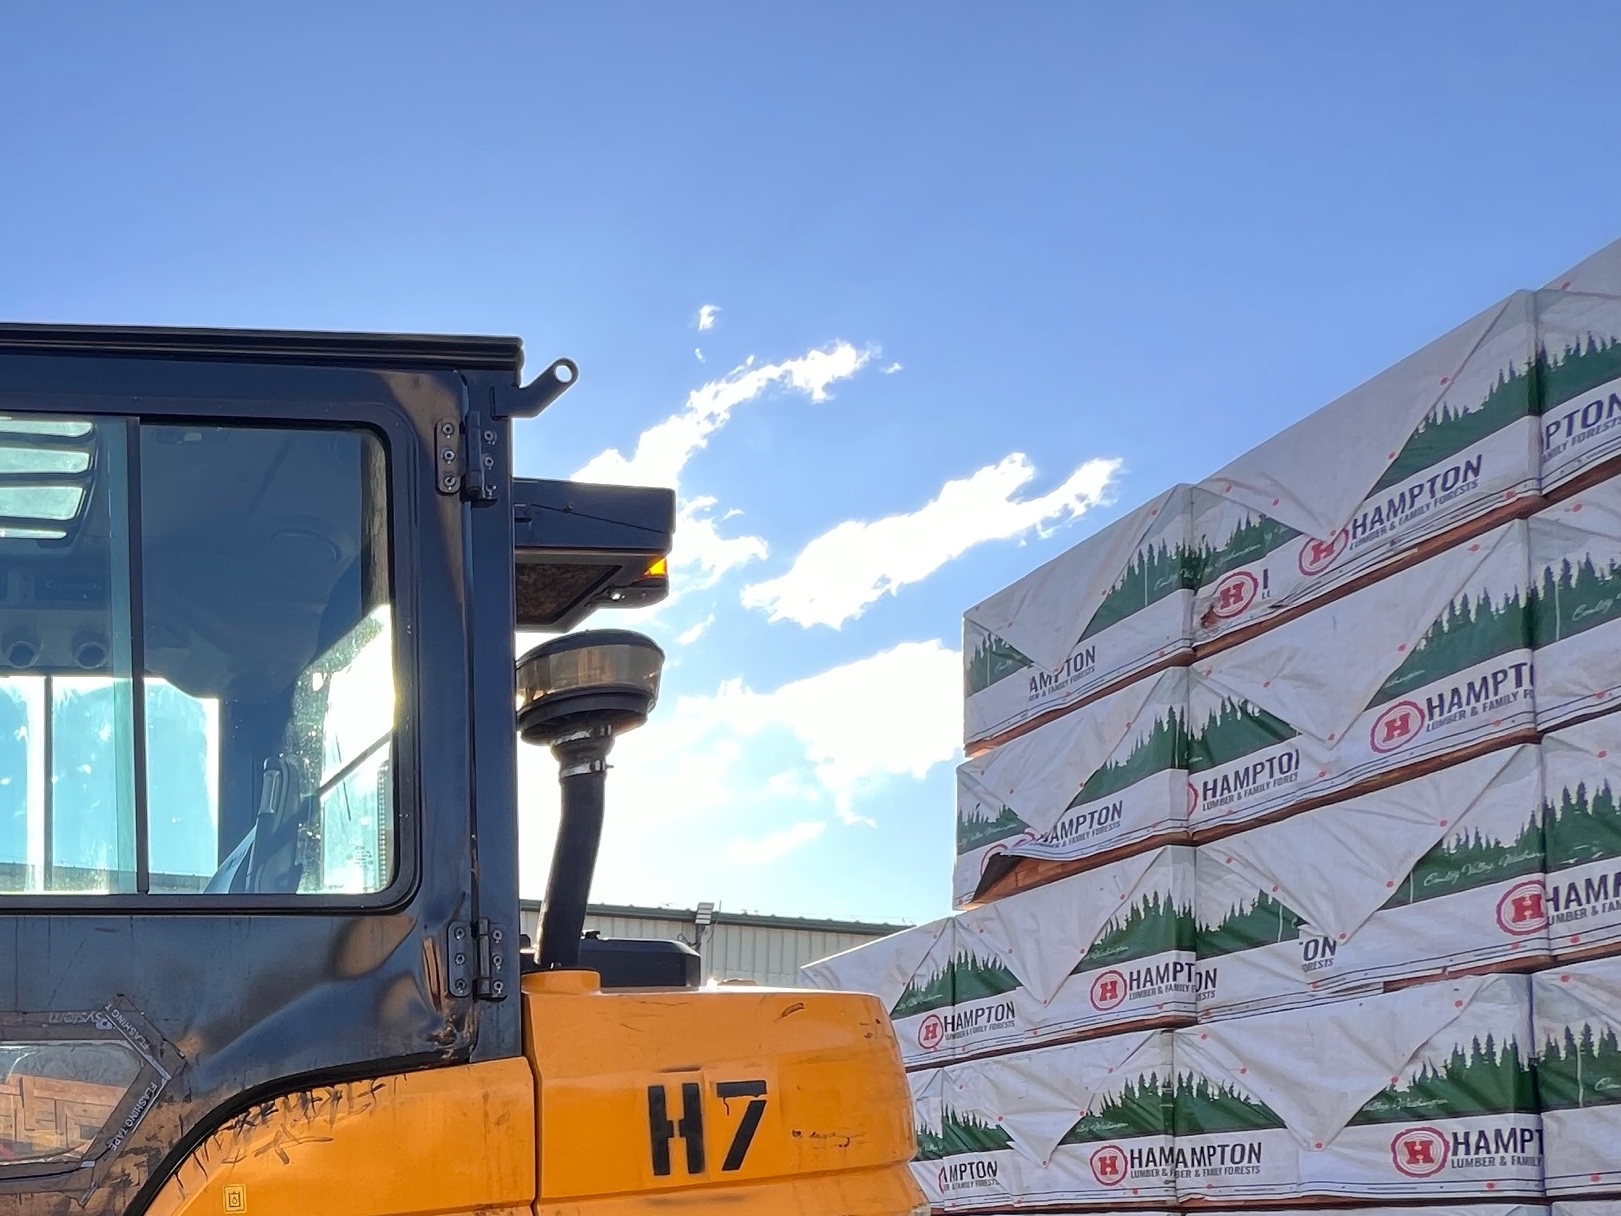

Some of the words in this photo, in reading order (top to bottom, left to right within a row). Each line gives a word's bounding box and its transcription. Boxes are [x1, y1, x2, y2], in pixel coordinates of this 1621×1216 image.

[1351, 454, 1482, 540] HAMPTON
[1434, 478, 1479, 508] FORESTS
[1482, 690, 1521, 713] FAMILY
[1129, 962, 1195, 991] HAMPT
[111, 1009, 151, 1050] FLASHING
[944, 1001, 1015, 1032] HAMPTON
[125, 1081, 158, 1127] FLASHING
[108, 1128, 129, 1151] TAPE
[648, 1080, 768, 1177] H7
[1131, 1169, 1160, 1179] LUMBER
[1224, 1165, 1260, 1176] FORESTS
[1451, 1156, 1495, 1169] LUMBER
[1499, 1155, 1506, 1166] &
